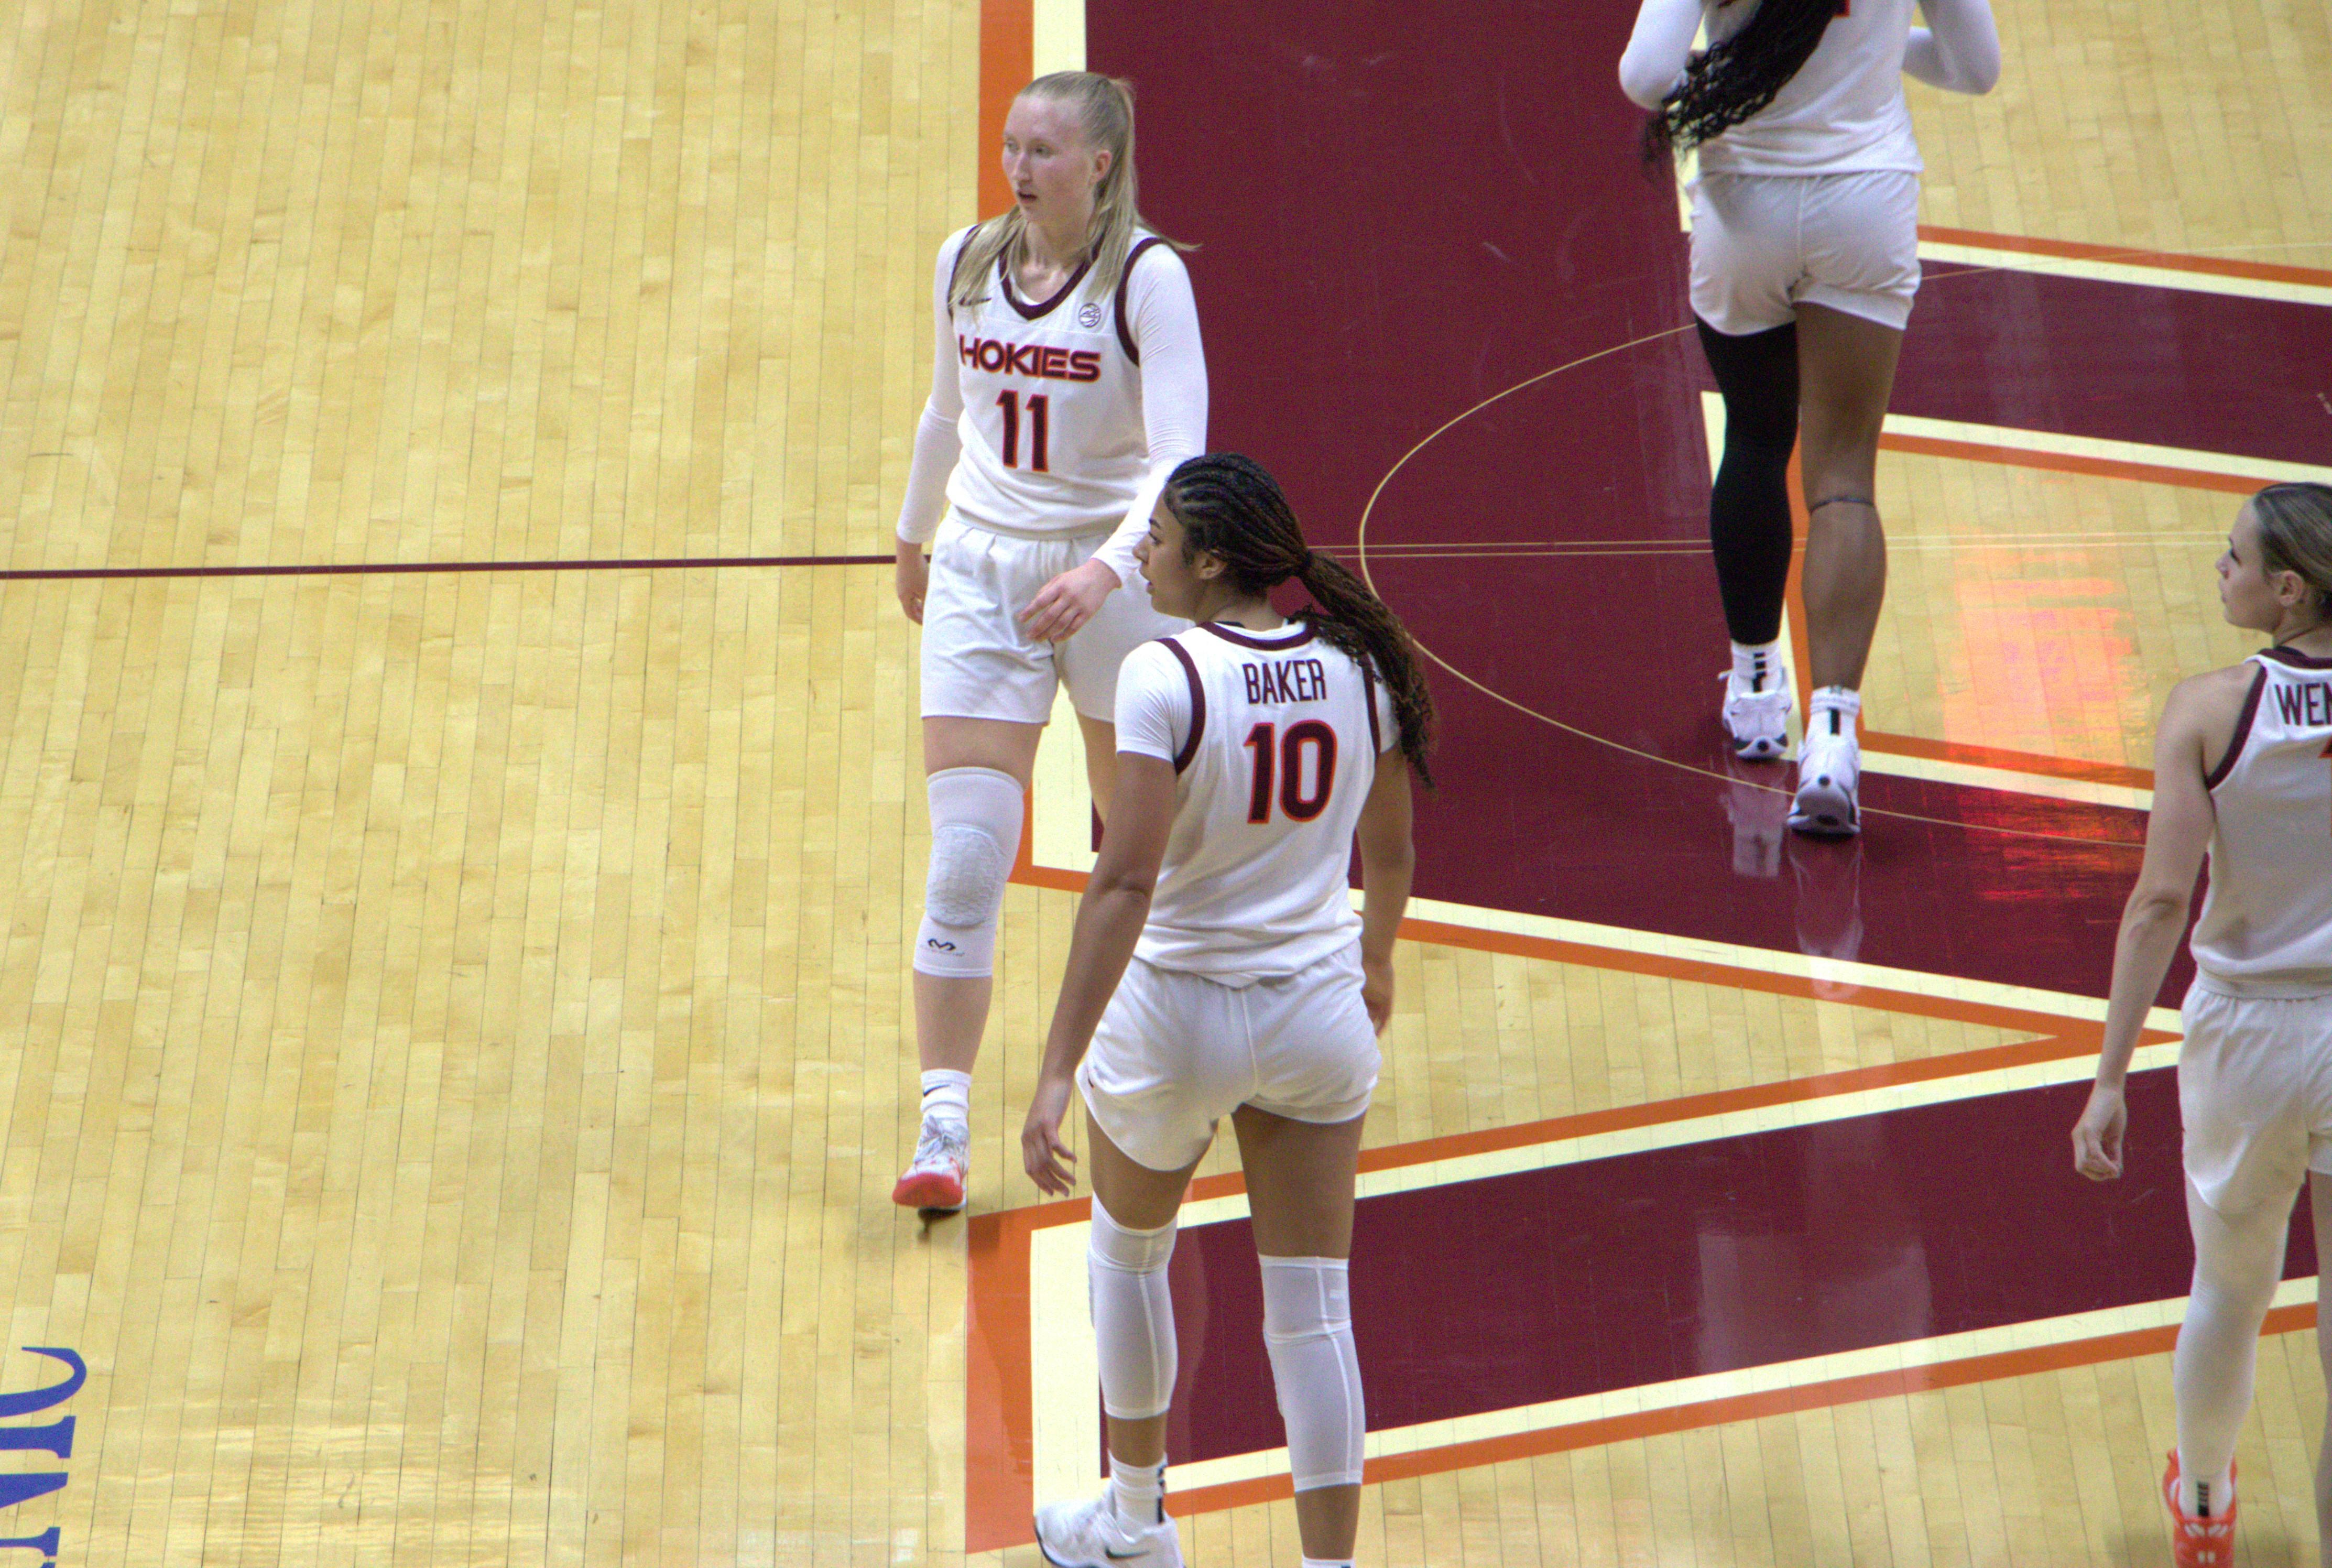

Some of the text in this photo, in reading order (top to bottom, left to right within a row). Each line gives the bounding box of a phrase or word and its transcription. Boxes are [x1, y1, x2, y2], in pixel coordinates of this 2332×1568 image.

[959, 334, 1100, 383] HOKIES
[996, 389, 1048, 472] 11
[1242, 659, 1327, 704] BAKER
[1244, 718, 1337, 824] 10
